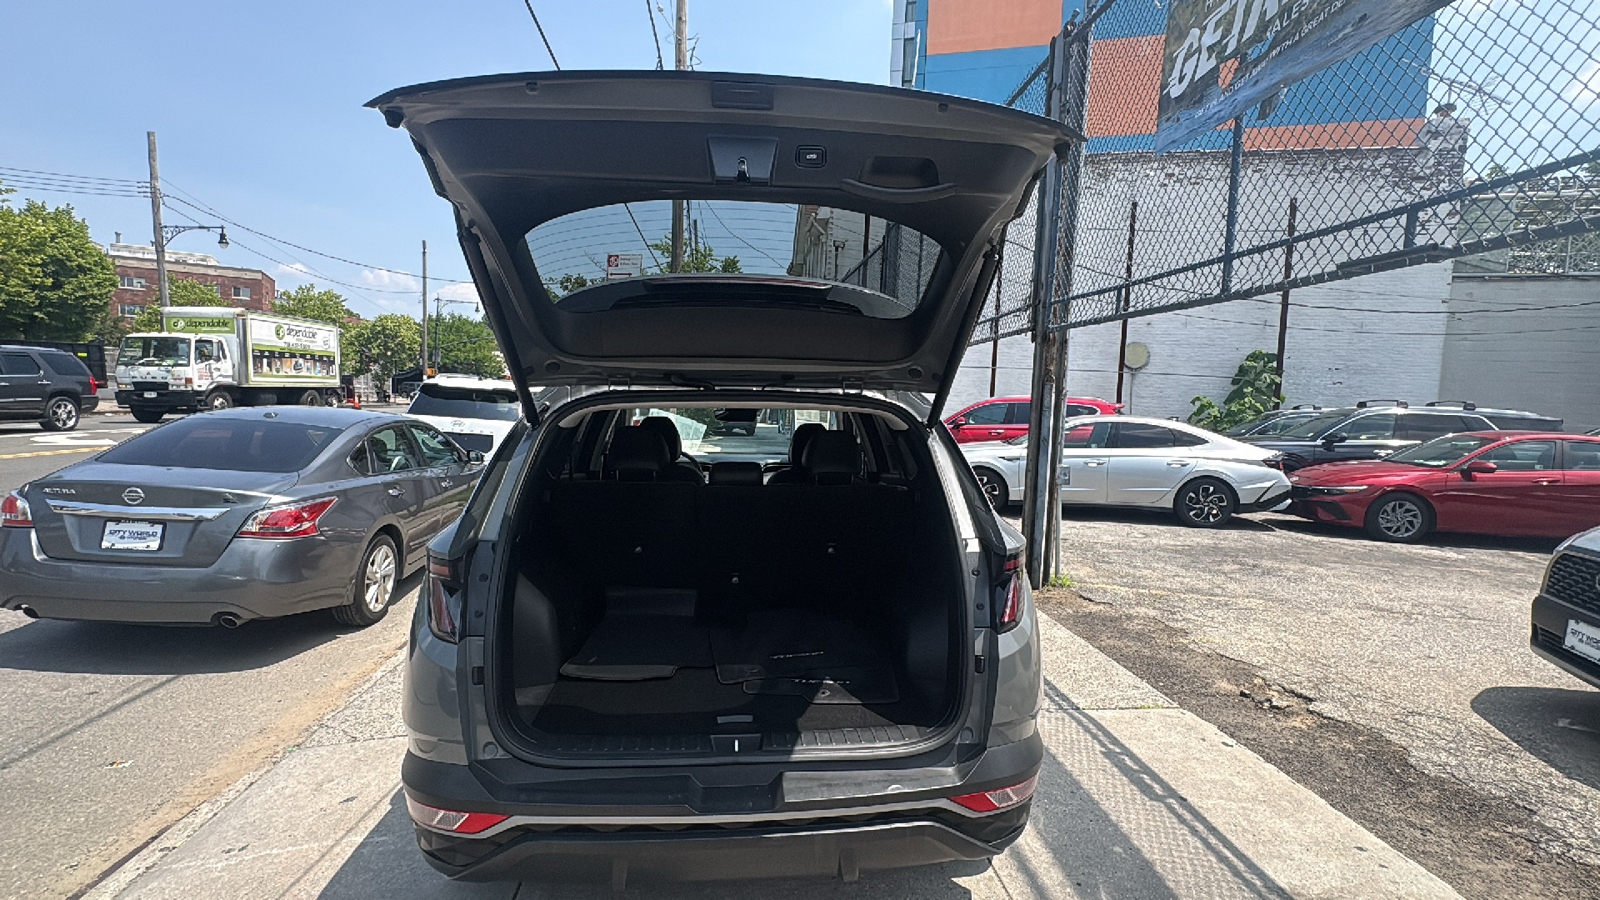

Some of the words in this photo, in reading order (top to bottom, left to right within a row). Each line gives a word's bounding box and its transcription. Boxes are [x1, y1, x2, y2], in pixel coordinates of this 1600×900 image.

[1301, 6, 1330, 37] GREAT
[186, 318, 230, 329] dependable
[286, 325, 318, 339] dependable
